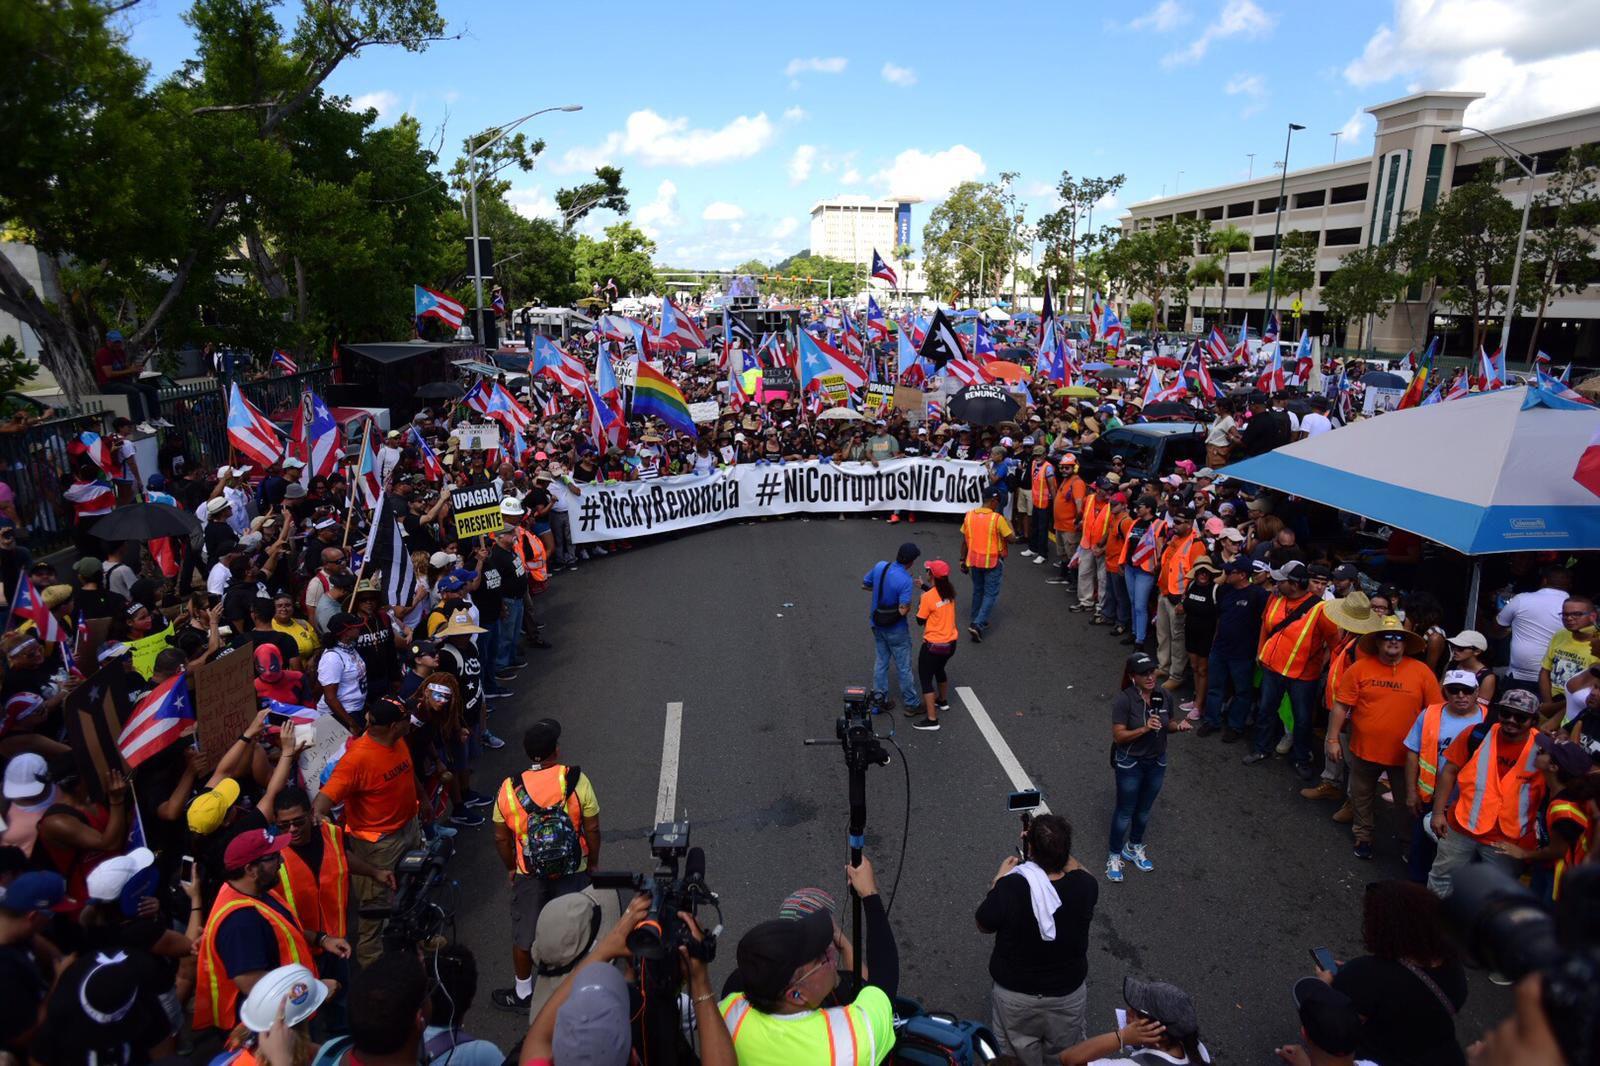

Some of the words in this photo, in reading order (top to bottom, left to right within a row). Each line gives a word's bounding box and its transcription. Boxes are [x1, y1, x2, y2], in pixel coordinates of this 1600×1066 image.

[869, 383, 894, 395] UPAGRA
[965, 391, 1006, 402] RENUNCIA
[452, 487, 497, 510] UPAGRA
[578, 475, 740, 531] #RickyRenuncia
[458, 513, 502, 535] PRESENTE
